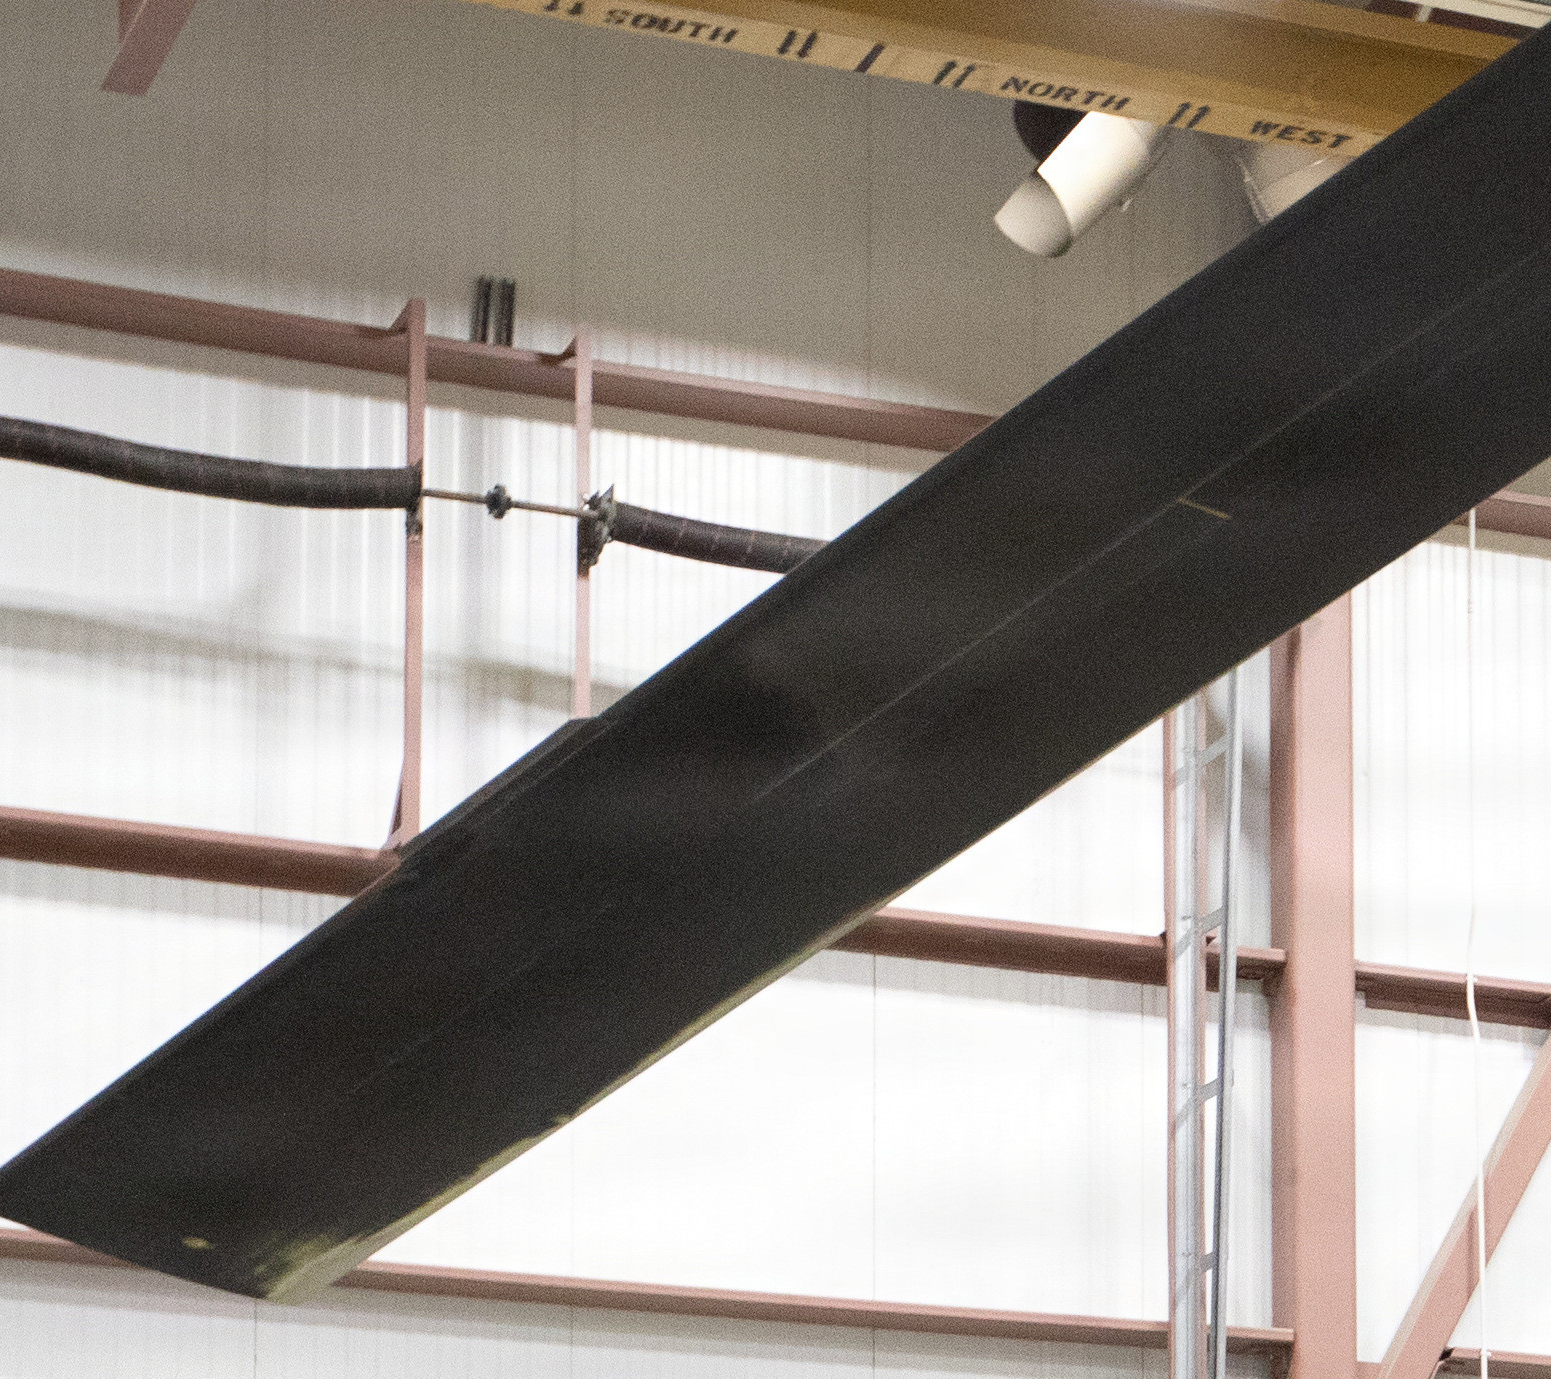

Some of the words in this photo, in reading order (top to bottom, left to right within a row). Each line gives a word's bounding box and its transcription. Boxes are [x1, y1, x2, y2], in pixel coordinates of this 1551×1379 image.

[604, 9, 739, 44] SOUTH
[1000, 76, 1131, 111] NORTH
[1250, 119, 1353, 149] WEST
